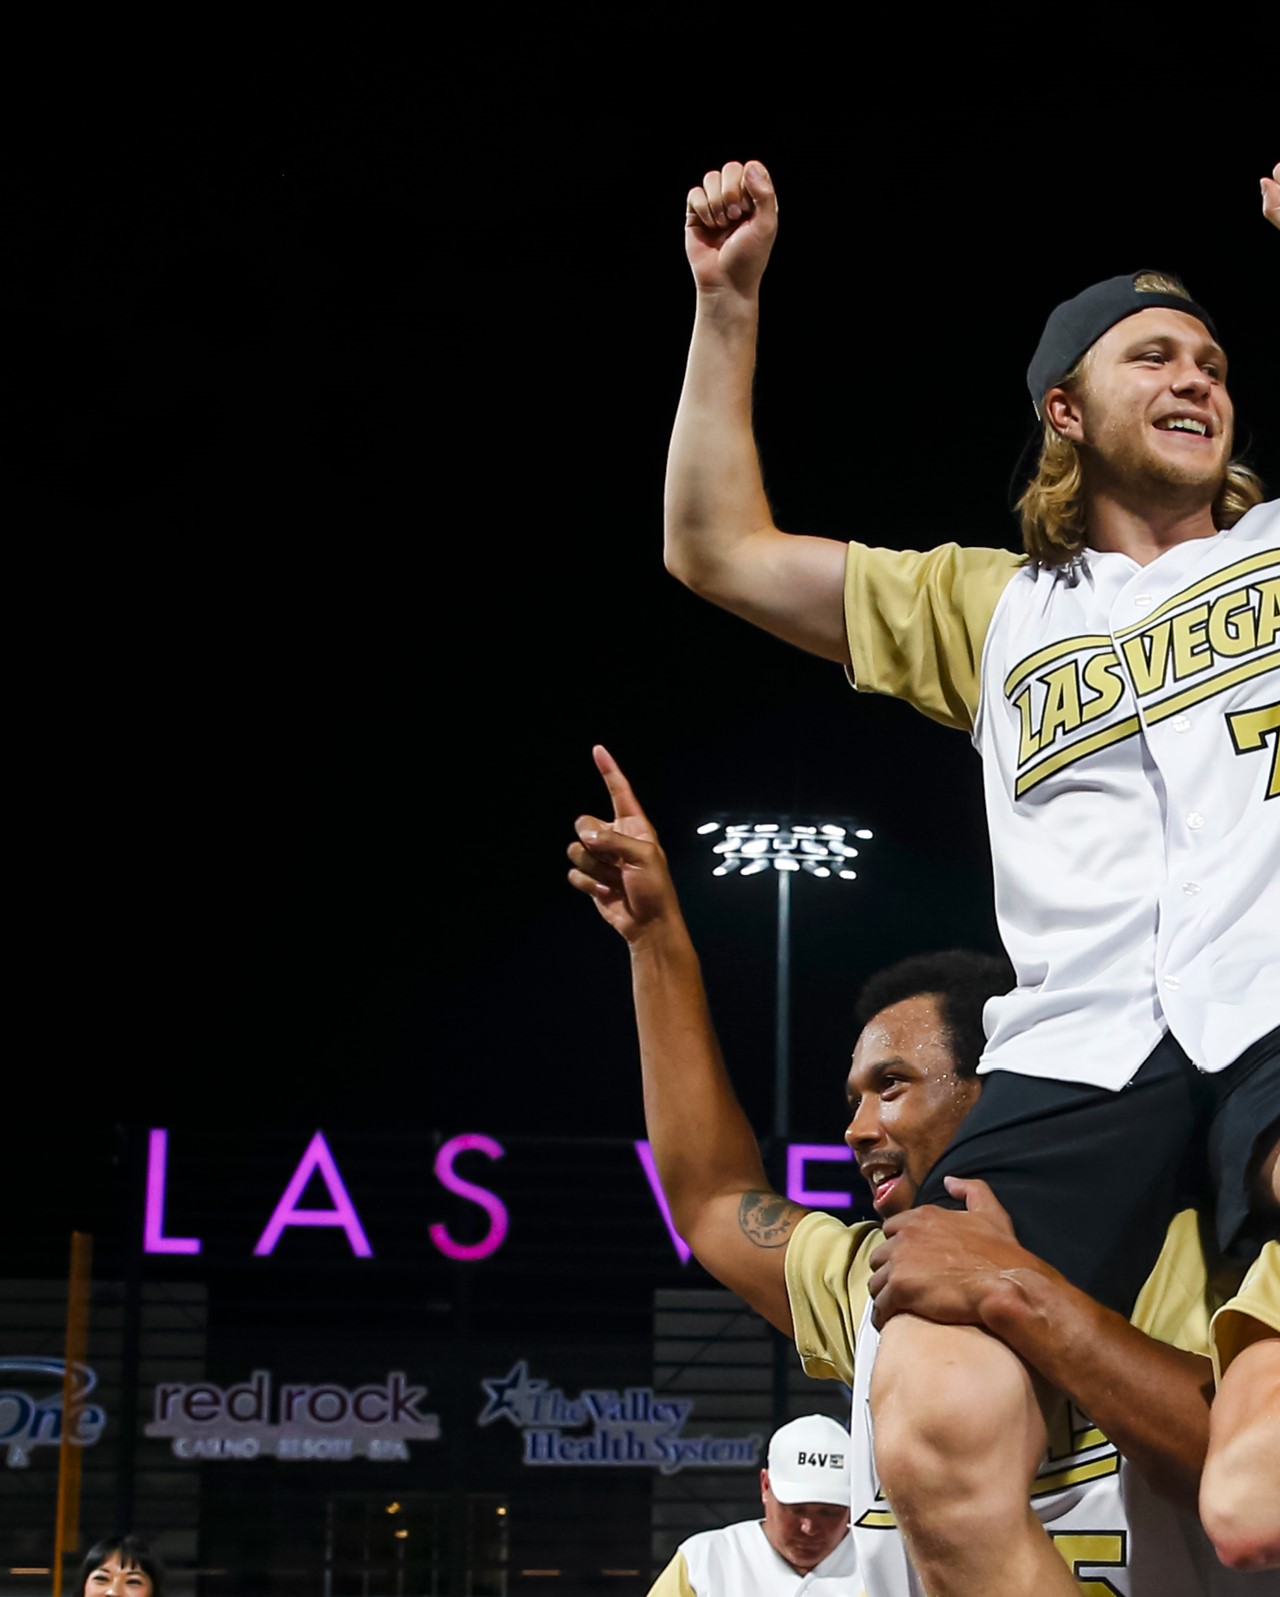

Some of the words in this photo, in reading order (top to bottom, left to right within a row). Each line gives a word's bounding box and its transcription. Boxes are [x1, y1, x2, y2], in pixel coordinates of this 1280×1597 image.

[1013, 652, 1124, 769] LAS
[144, 1129, 509, 1260] LAS
[158, 1371, 268, 1422] red
[286, 1372, 424, 1424] rock
[583, 1390, 691, 1430] Valley
[528, 1431, 647, 1462] Health
[652, 1436, 760, 1471] System
[798, 1451, 828, 1467] B4V
